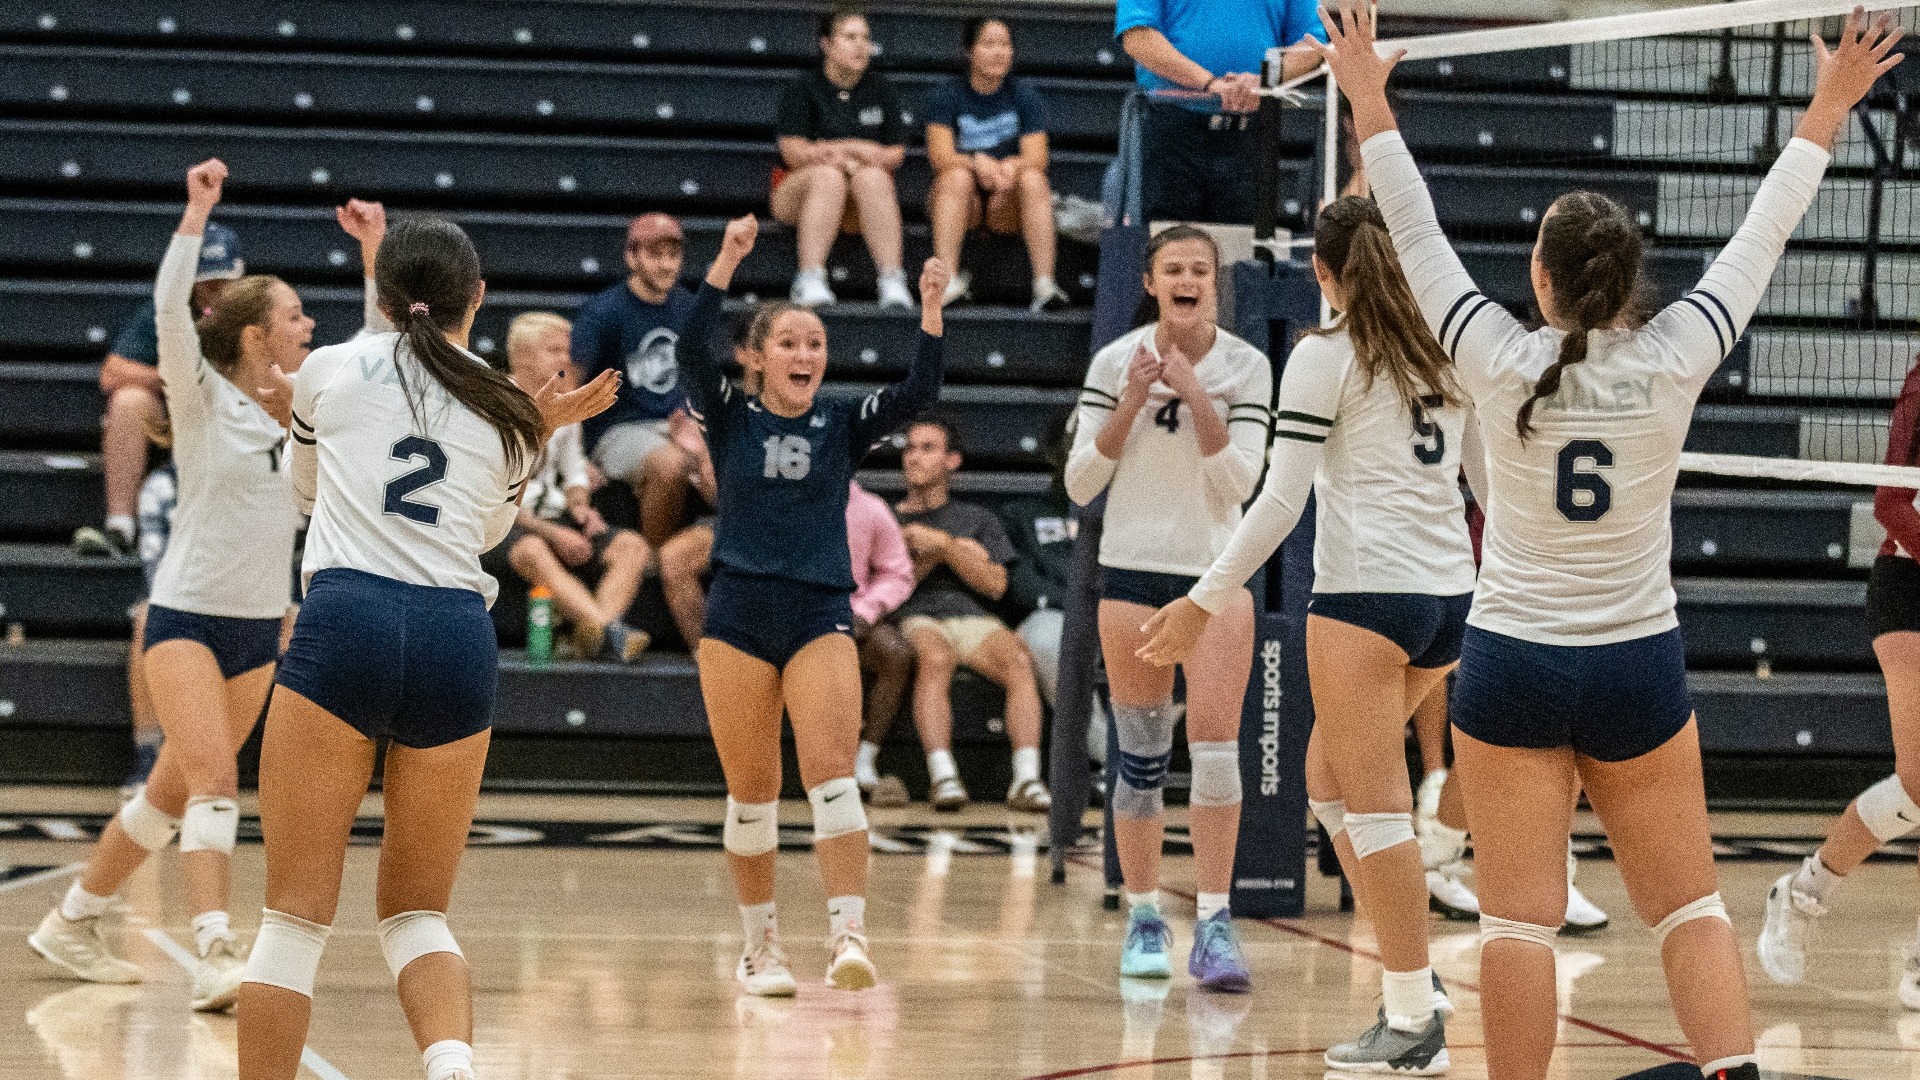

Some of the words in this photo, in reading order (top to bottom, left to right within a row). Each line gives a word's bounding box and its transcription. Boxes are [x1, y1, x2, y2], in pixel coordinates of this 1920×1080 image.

[1155, 397, 1182, 434] 4
[1411, 394, 1445, 466] 5
[382, 434, 450, 527] 2
[763, 434, 811, 480] 16
[1553, 438, 1615, 523] 6
[1260, 640, 1283, 709] sports
[1258, 711, 1281, 796] imports
